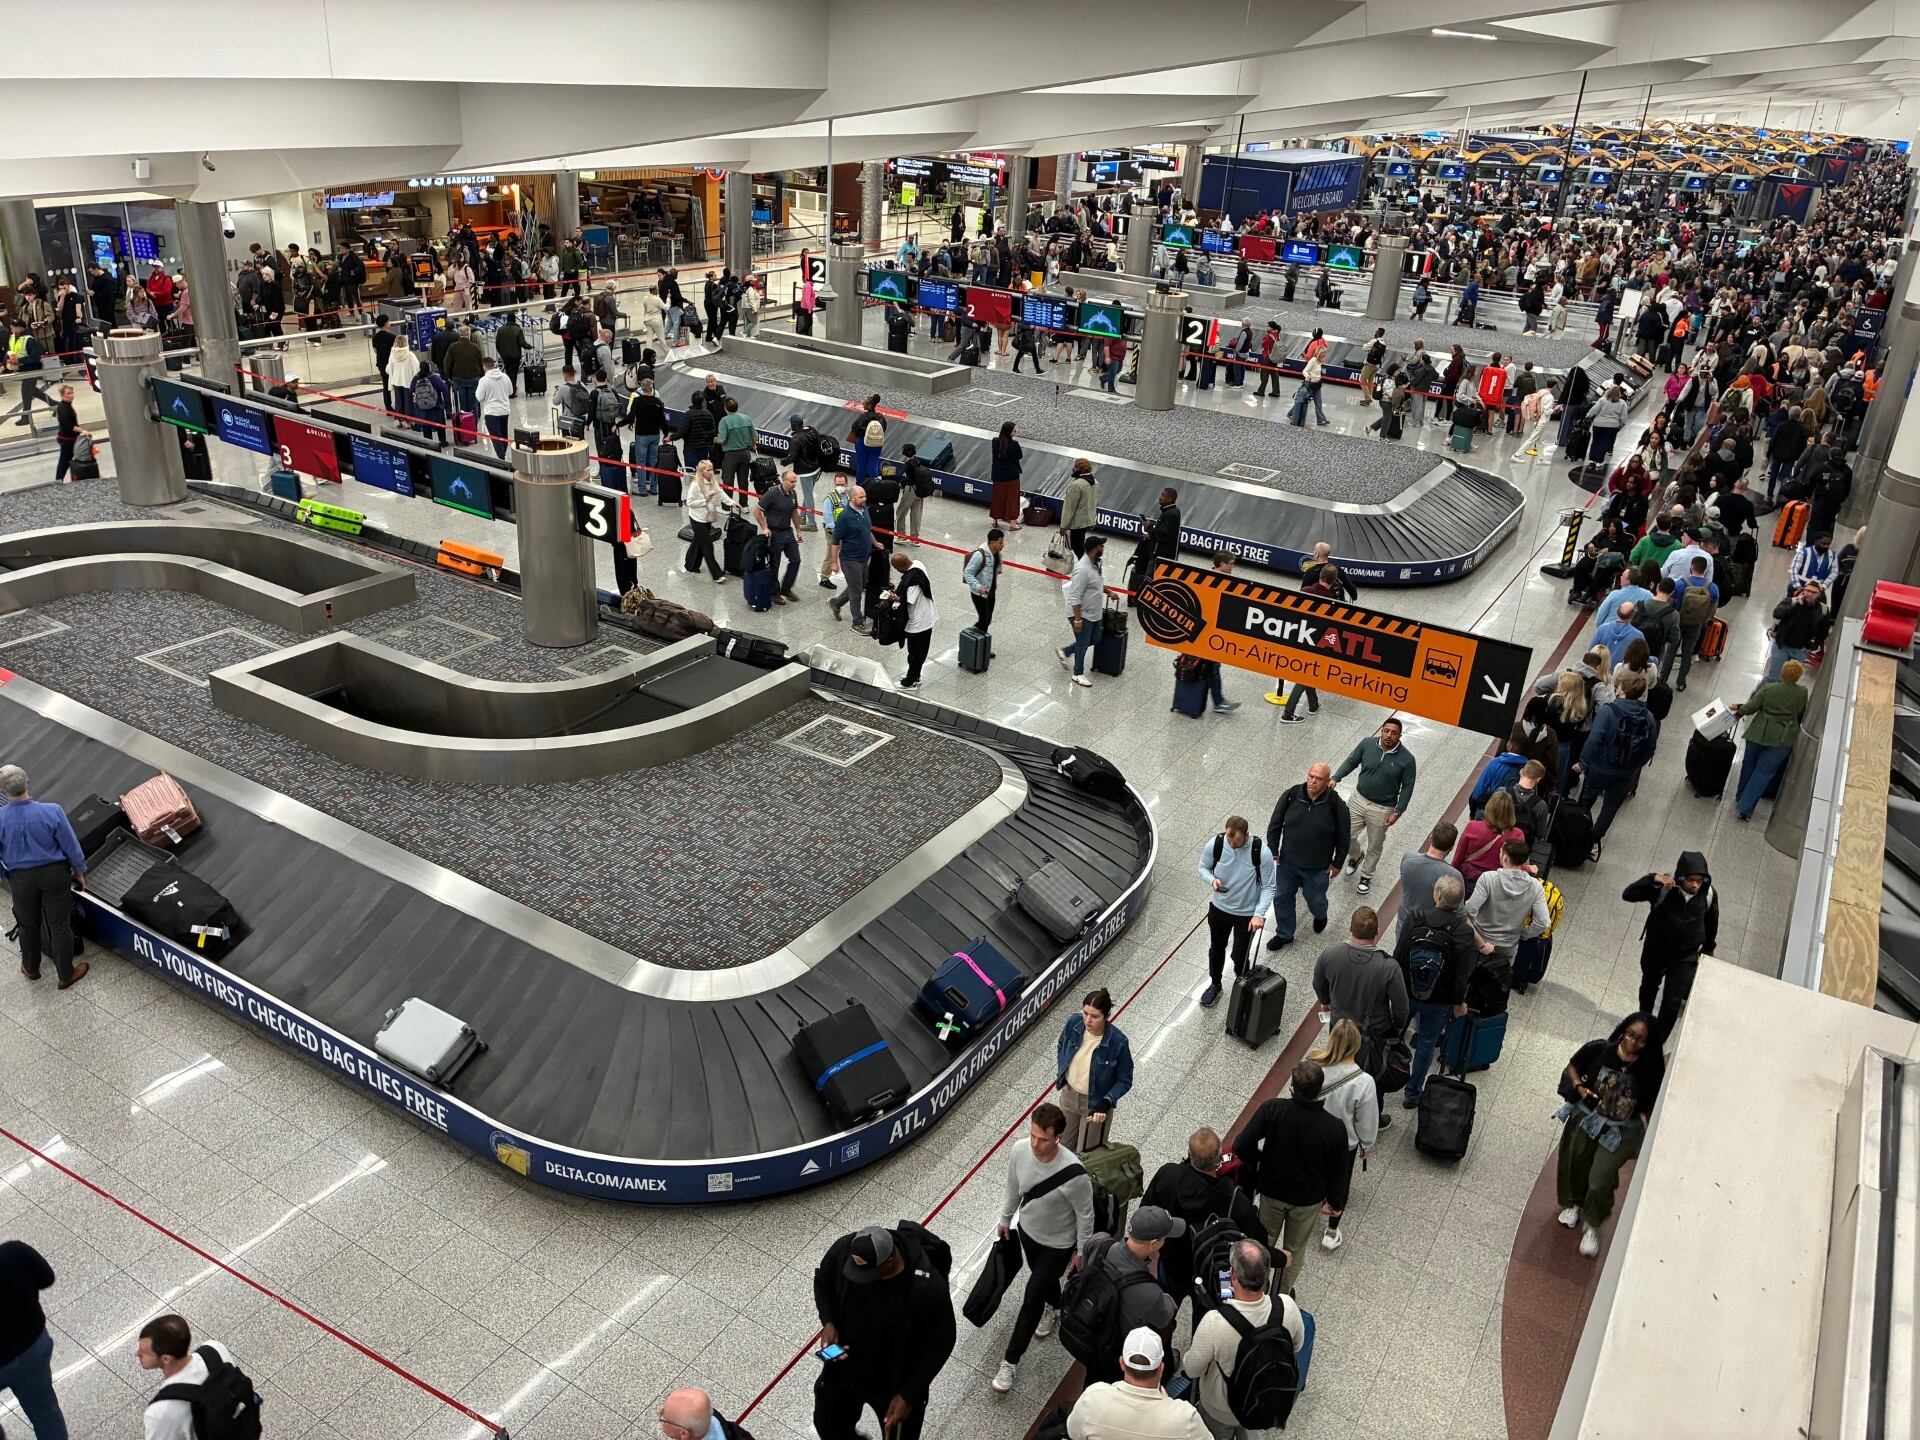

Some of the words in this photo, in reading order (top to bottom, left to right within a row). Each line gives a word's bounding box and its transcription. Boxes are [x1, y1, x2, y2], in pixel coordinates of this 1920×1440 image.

[1292, 193, 1321, 210] WELCOME
[1321, 189, 1344, 206] ABOARD
[1118, 218, 1124, 234] 1
[1241, 247, 1246, 258] 1
[1412, 254, 1419, 273] 1
[811, 260, 825, 282] 2
[967, 303, 976, 318] 2
[1186, 320, 1204, 345] 2
[310, 429, 327, 438] DELTA
[757, 433, 790, 451] HECKED
[280, 444, 293, 466] 3
[583, 495, 608, 537] 3
[1112, 516, 1141, 533] FIRST
[1190, 533, 1212, 550] BAG
[1213, 539, 1242, 556] FLIES
[1243, 547, 1272, 563] FREE
[1142, 590, 1195, 632] DETOUR
[1207, 634, 1321, 678] On-Airport
[1326, 664, 1409, 703] Parking
[133, 932, 163, 968] ATL,
[162, 948, 204, 989] YOUR
[204, 969, 245, 1011] FIRST
[247, 997, 319, 1053] CHECKED
[321, 1038, 356, 1076] BAG
[357, 1059, 402, 1102] FLIES
[889, 1107, 928, 1145] ATL,
[929, 1063, 969, 1116] YOUR
[969, 1033, 1003, 1080] FIRST
[1003, 976, 1055, 1042] CHECKED
[1055, 959, 1077, 988] BAG
[1078, 929, 1104, 966] FLIES
[545, 1160, 667, 1192] DELTA.COM/AMEX
